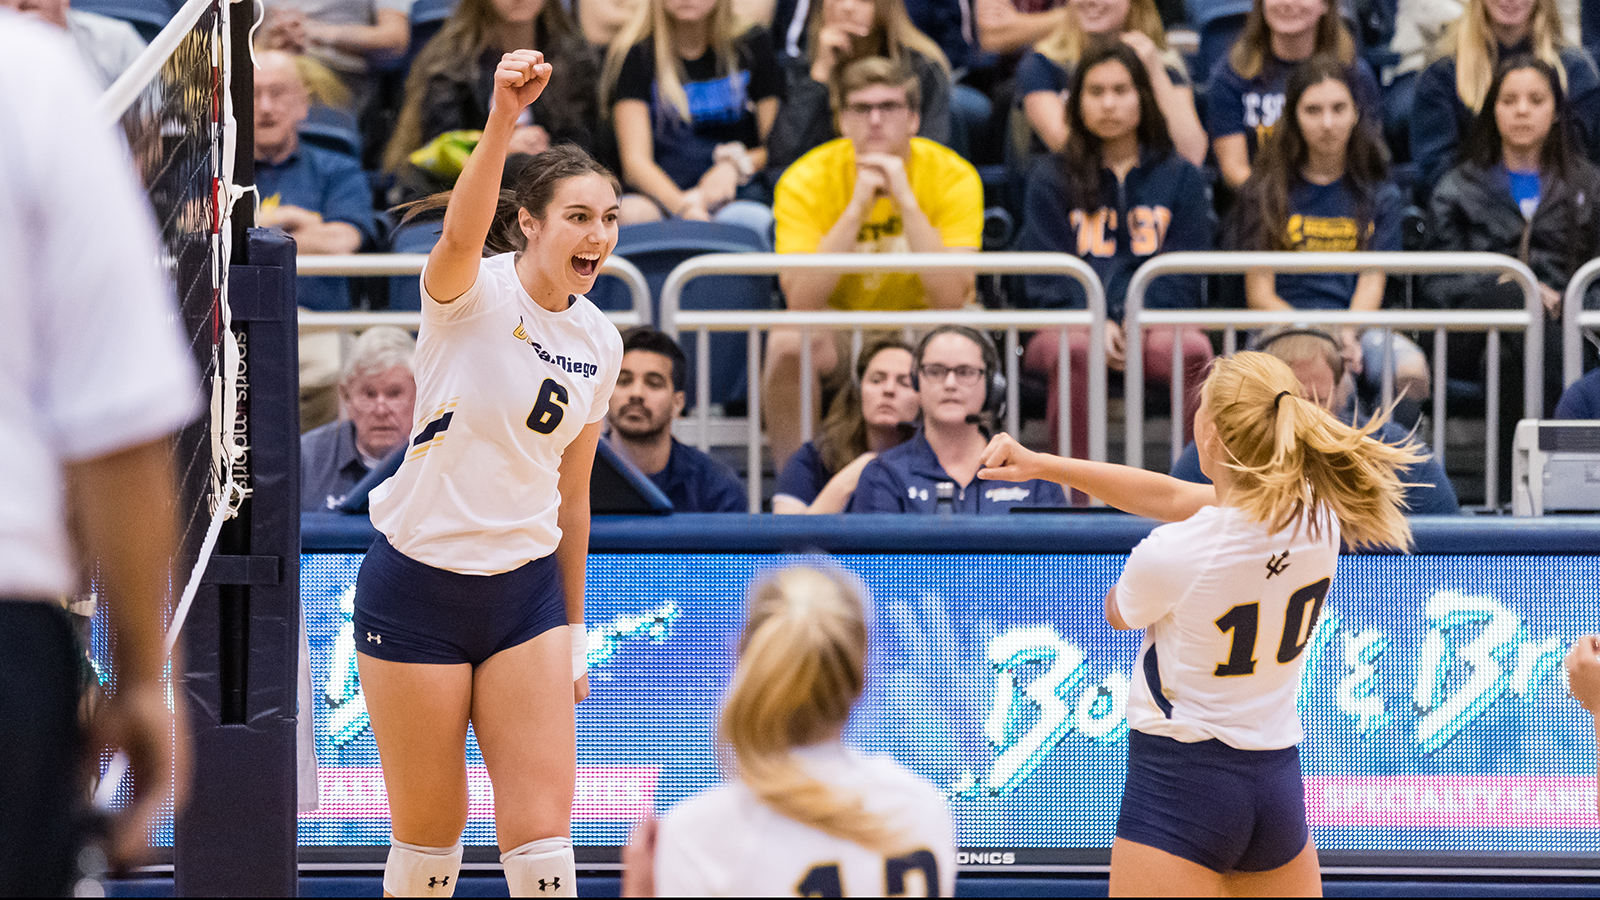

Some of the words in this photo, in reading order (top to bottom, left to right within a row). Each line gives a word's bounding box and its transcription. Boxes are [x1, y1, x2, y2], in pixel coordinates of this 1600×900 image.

[526, 377, 569, 436] 6
[1213, 576, 1331, 677] 10
[956, 852, 1015, 865] ONICS
